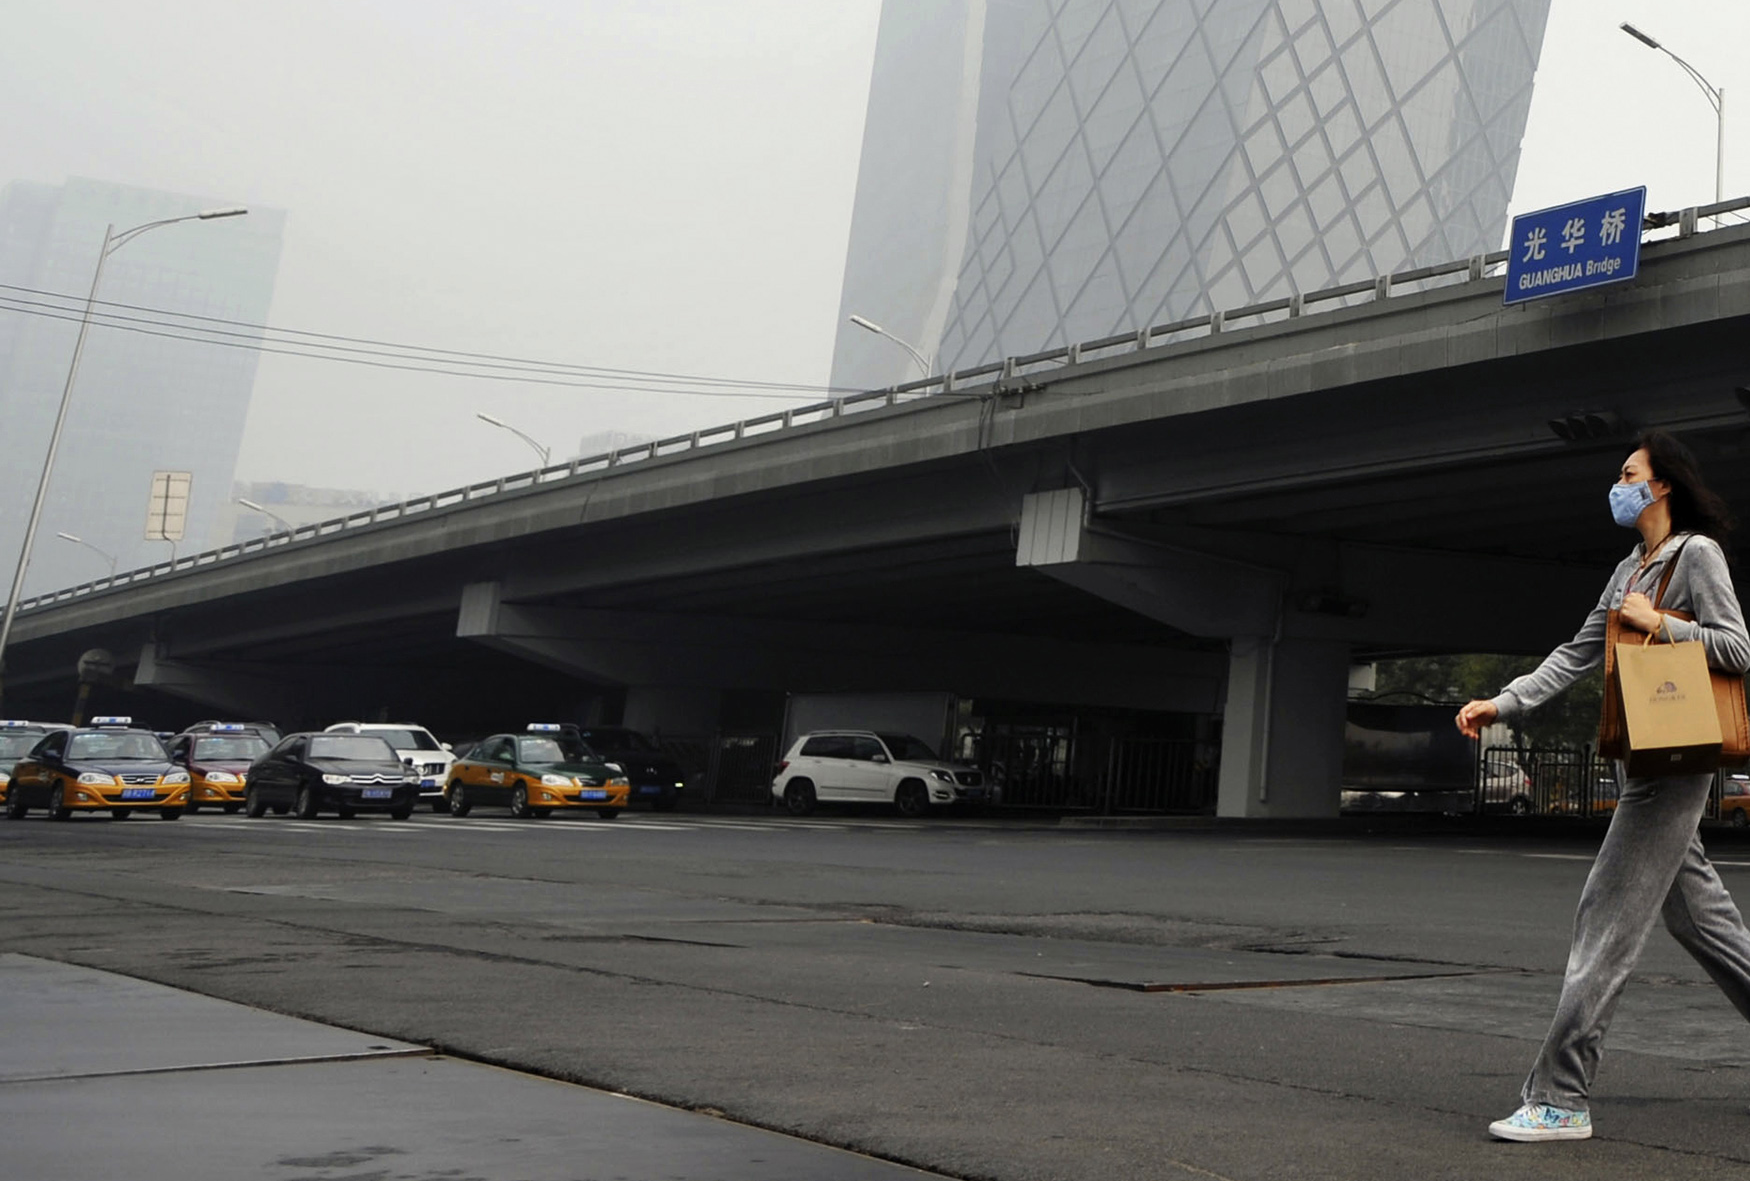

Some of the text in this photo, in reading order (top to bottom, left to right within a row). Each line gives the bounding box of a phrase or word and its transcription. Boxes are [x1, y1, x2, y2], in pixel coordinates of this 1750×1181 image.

[1522, 208, 1626, 262] 光华桥
[1519, 257, 1621, 289] GUANGHUA Bridge
